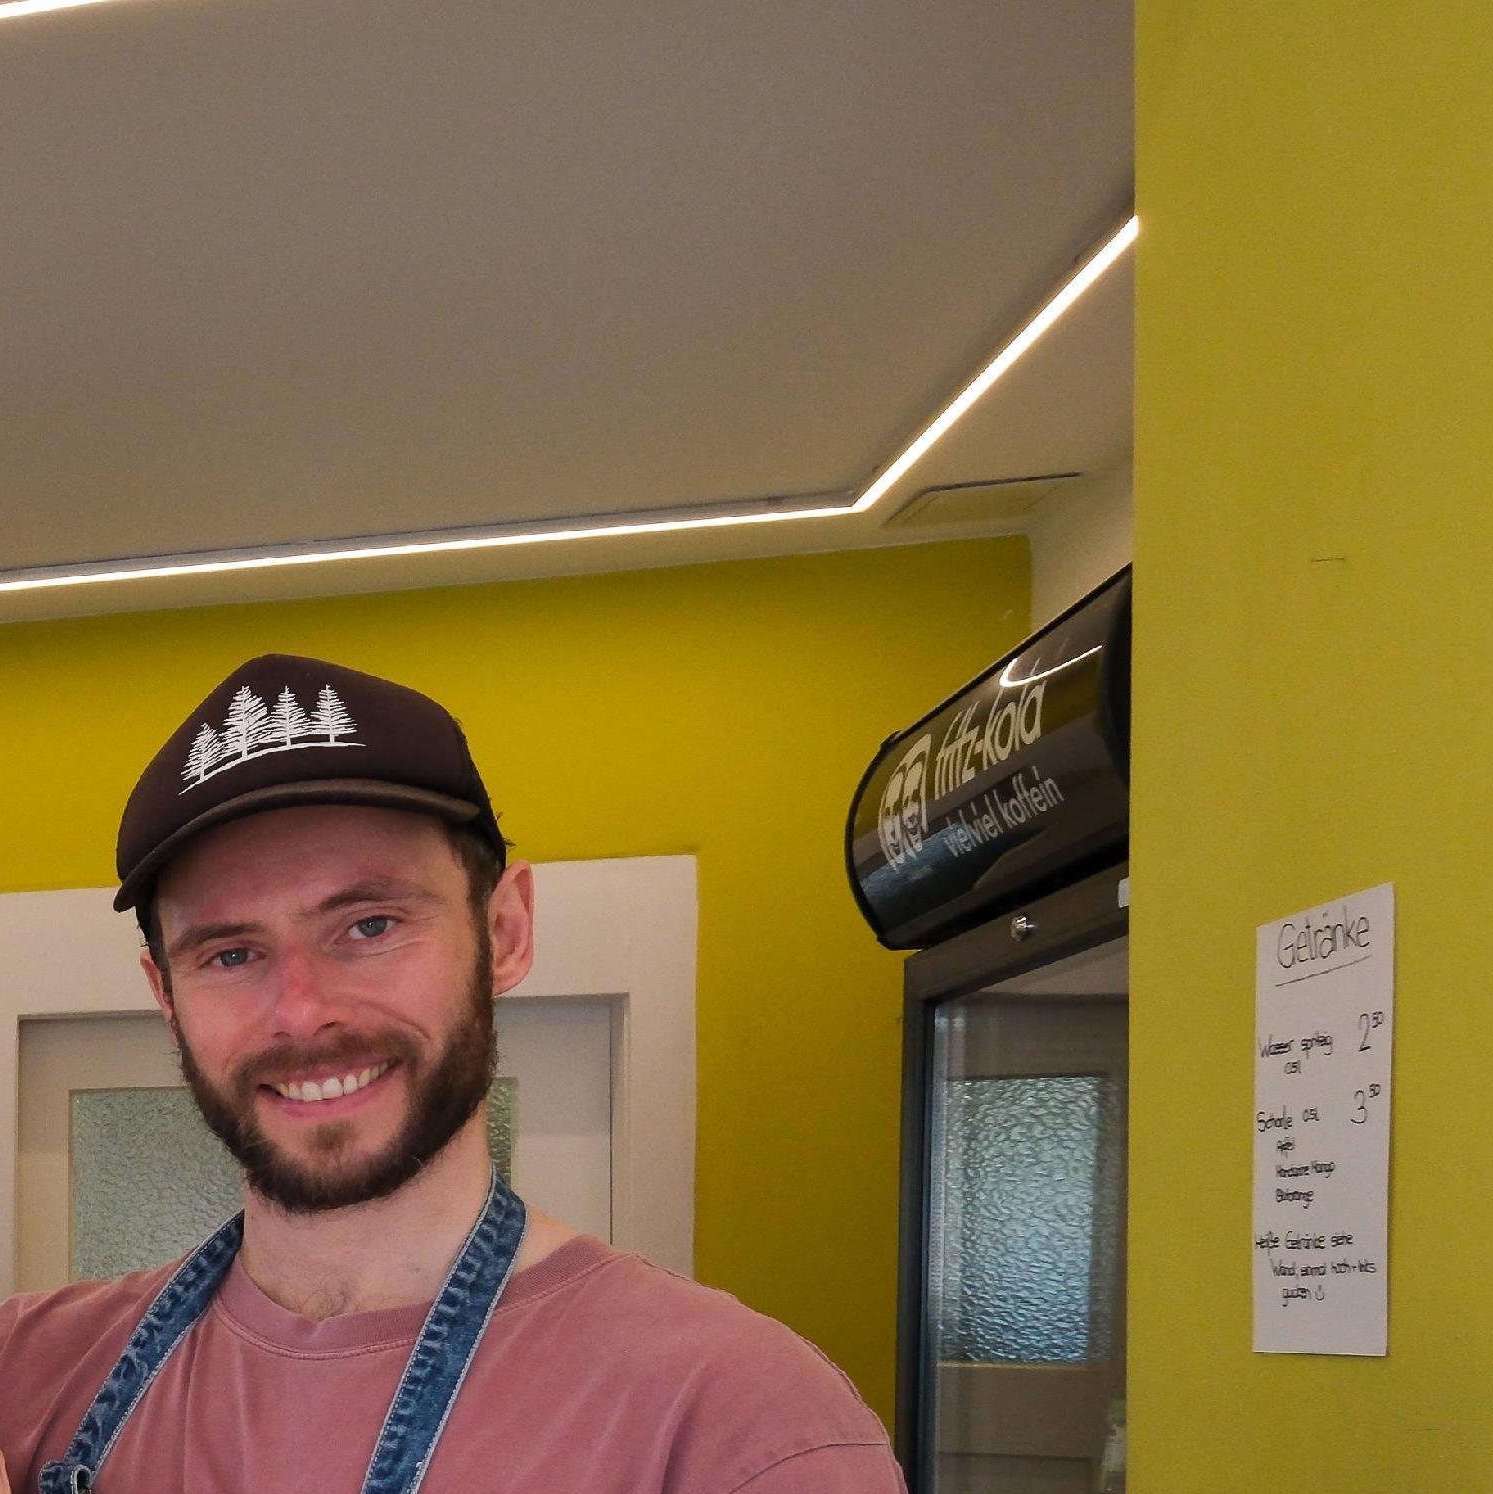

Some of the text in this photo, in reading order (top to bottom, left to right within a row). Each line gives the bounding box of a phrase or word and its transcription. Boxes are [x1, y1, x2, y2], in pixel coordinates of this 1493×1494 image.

[935, 657, 1047, 800] fritz-kola
[993, 766, 1064, 829] koffein
[1277, 904, 1371, 969] Getränke
